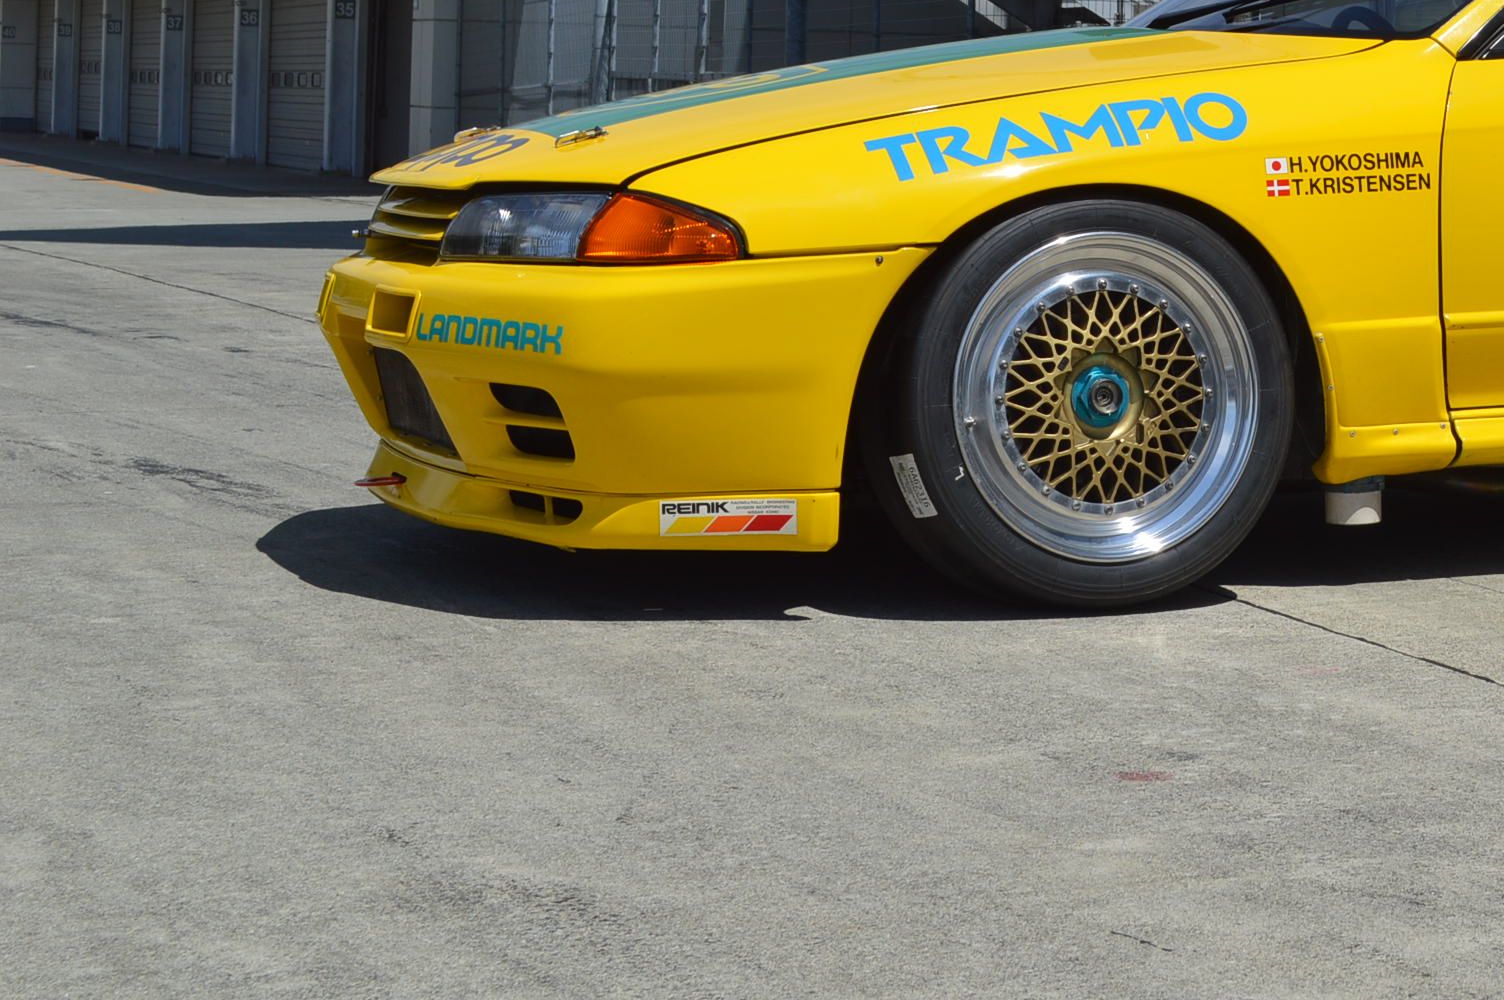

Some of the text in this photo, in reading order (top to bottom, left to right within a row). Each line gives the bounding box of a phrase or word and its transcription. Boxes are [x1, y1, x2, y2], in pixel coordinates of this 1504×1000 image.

[241, 11, 257, 24] 36
[336, 2, 354, 16] 35
[168, 17, 182, 29] 37
[863, 92, 1248, 182] TRAMPIO
[1289, 151, 1425, 174] H.YOKOSHIMA
[1291, 173, 1432, 196] T.KRISTENSEN
[417, 312, 564, 356] LANDMARK
[661, 501, 730, 515] REINIK
